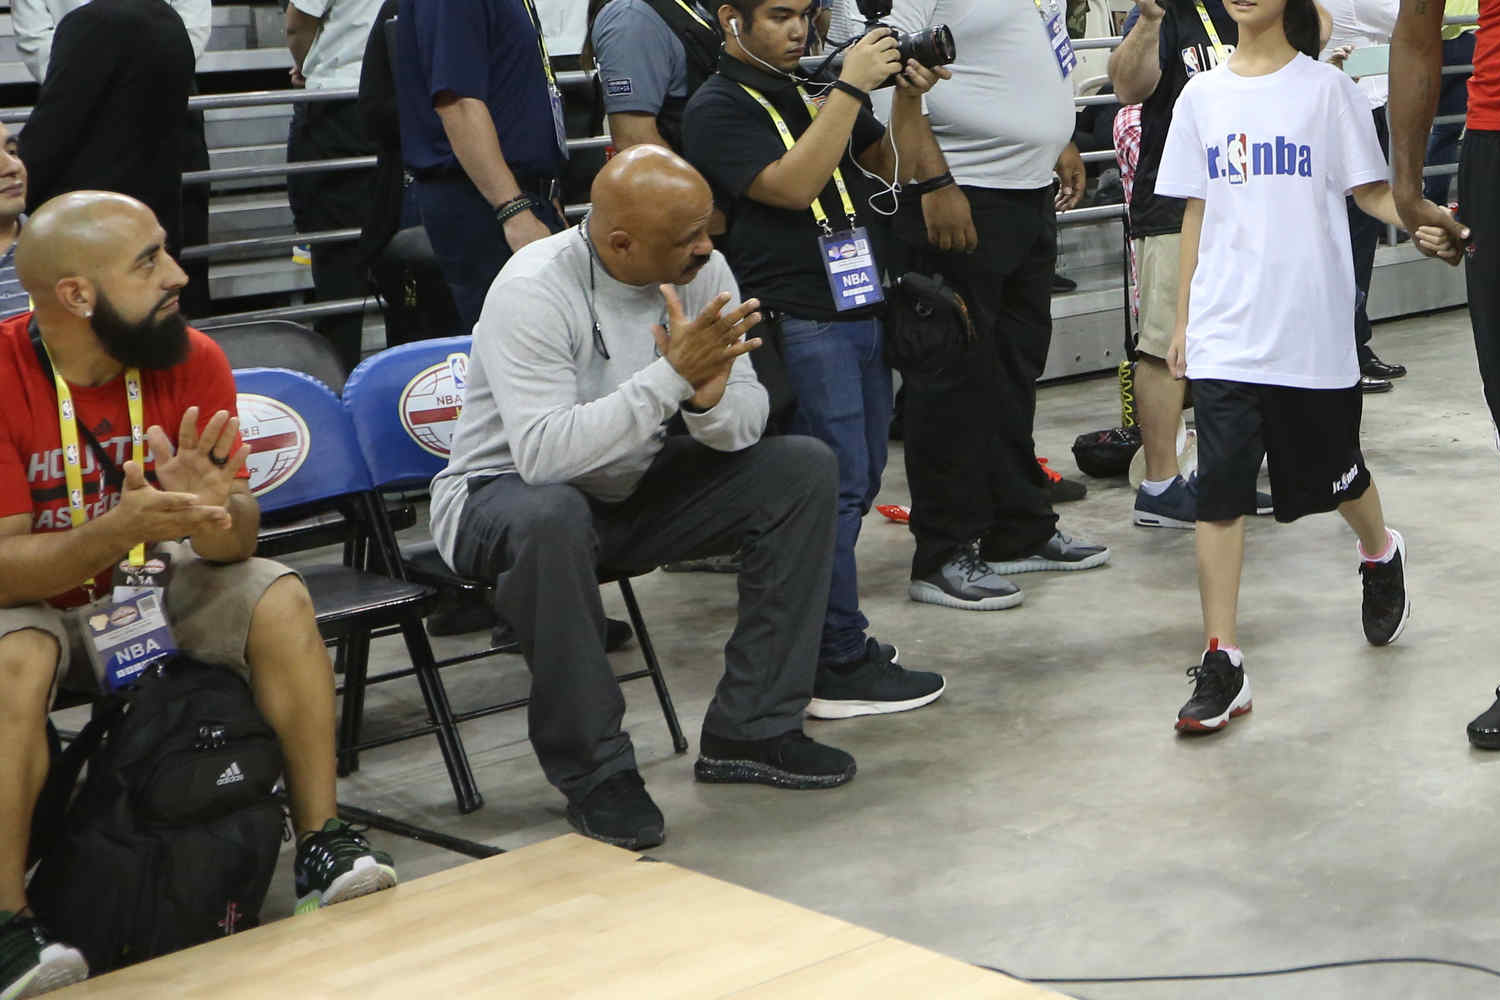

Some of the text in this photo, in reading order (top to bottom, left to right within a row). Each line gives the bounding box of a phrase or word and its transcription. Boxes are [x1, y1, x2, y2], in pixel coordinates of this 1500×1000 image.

[1206, 135, 1313, 180] r. nba
[842, 271, 870, 288] NBA
[115, 638, 161, 665] NBA
[216, 773, 245, 786] adidas
